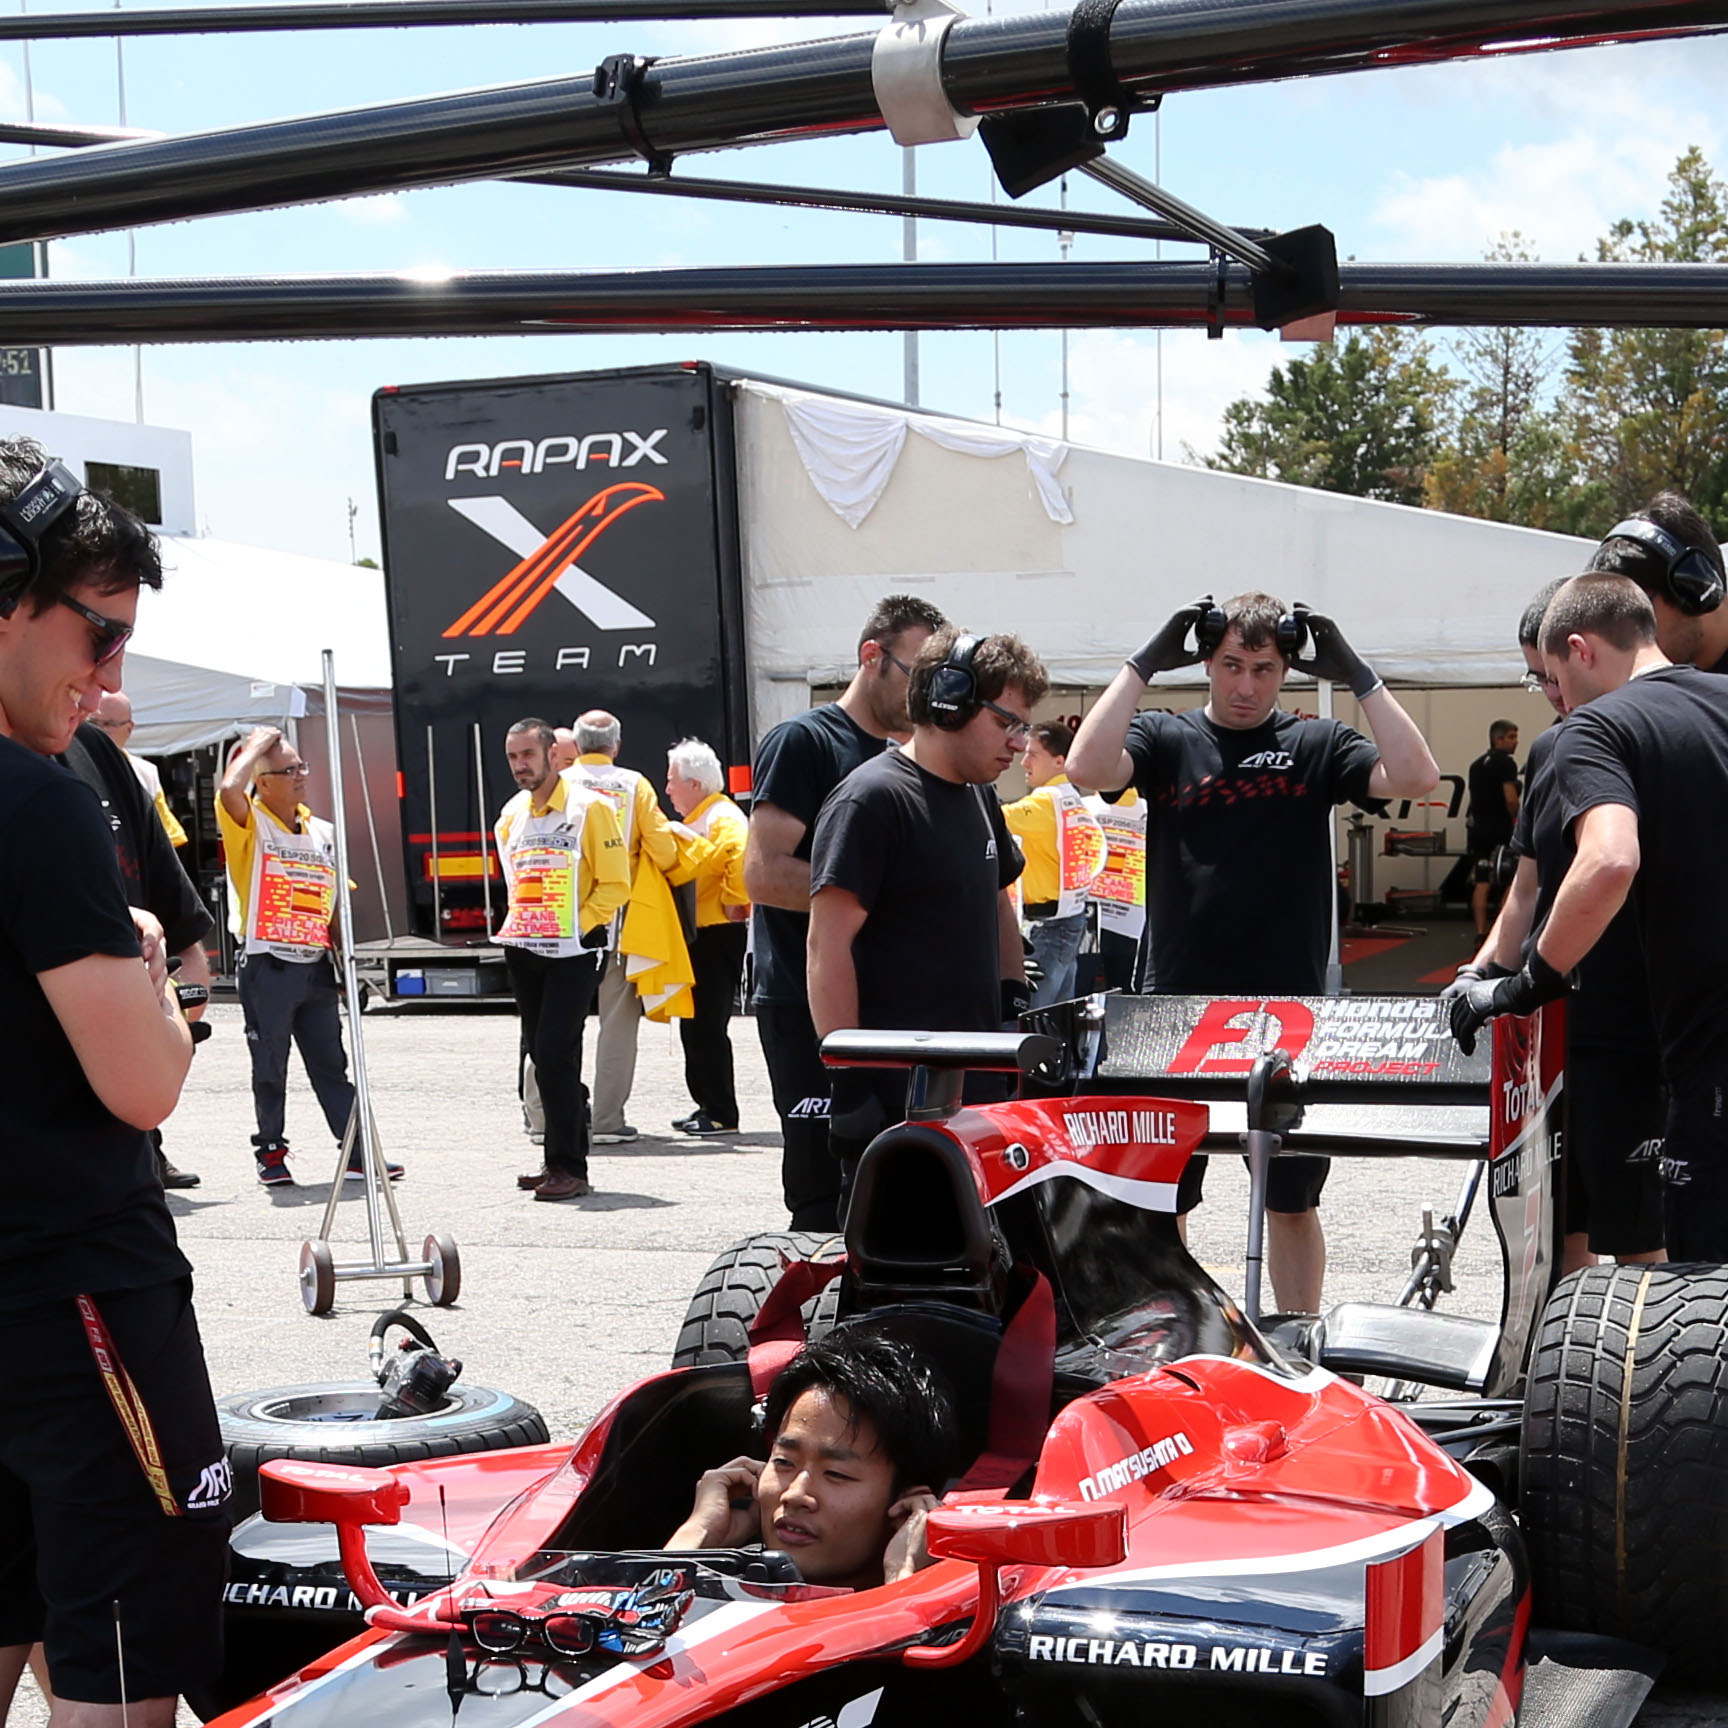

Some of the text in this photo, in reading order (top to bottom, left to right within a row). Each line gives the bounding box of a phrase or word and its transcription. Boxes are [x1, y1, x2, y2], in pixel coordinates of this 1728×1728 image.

[445, 429, 669, 480] RAPAX
[435, 643, 657, 676] TEAM
[1322, 1000, 1437, 1018] Honda
[1314, 1041, 1429, 1058] DREAM
[1312, 1060, 1441, 1076] PROJECT
[1063, 1111, 1176, 1147] RICHARD MILLE
[1628, 1138, 1666, 1158] AR
[955, 1505, 1077, 1515] TOTAL
[222, 1582, 338, 1609] ICHARD
[1029, 1635, 1330, 1677] RICHARD MILLE
